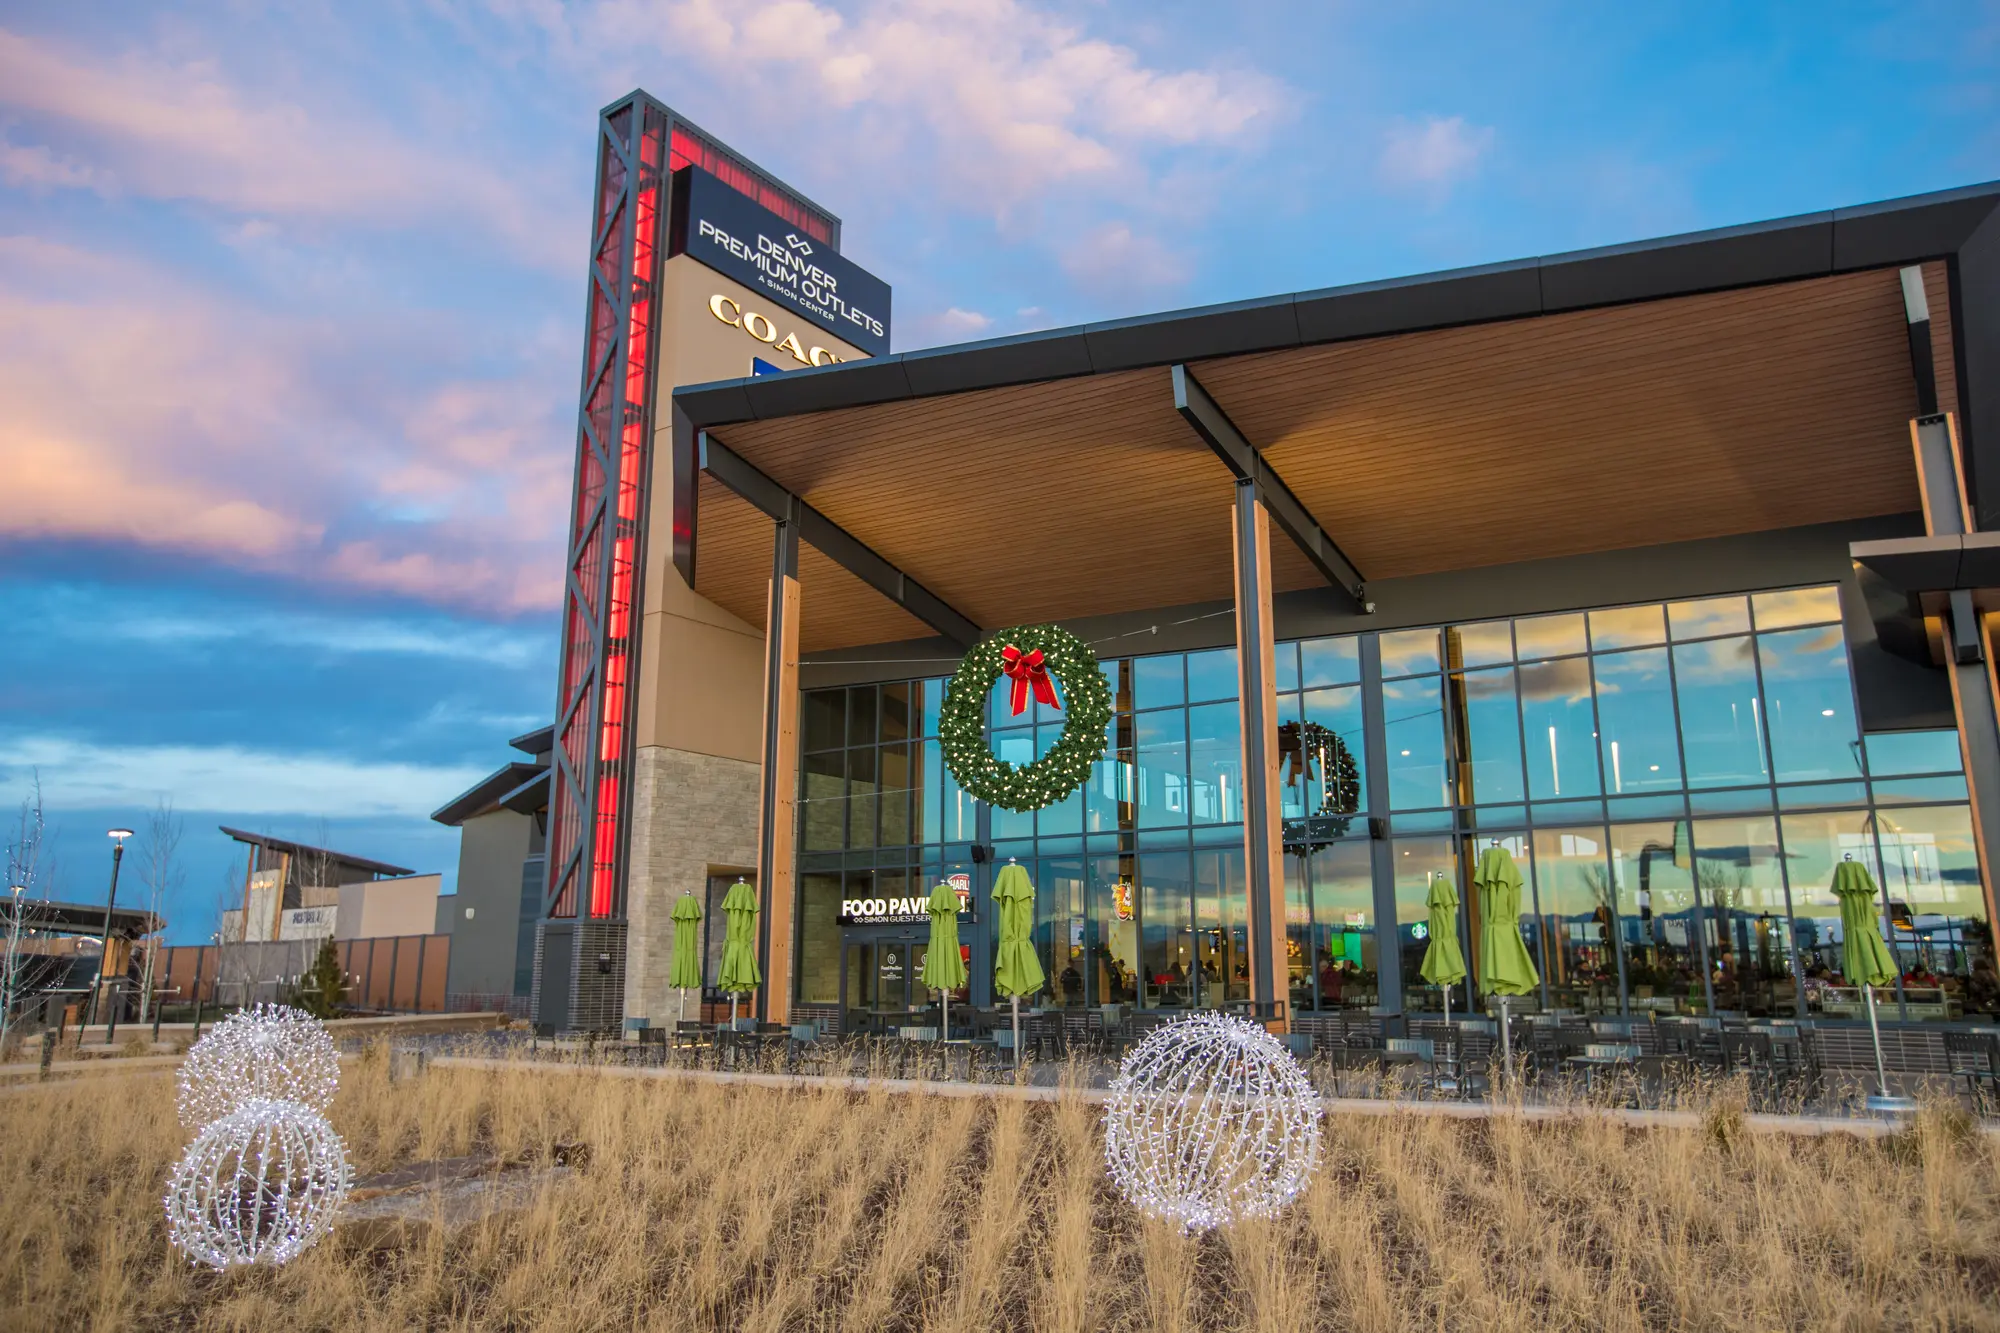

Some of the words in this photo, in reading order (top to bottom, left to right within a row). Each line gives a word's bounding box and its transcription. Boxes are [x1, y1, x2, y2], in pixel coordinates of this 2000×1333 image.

[699, 219, 797, 288] PREMIUM
[802, 280, 884, 337] OUTLETS
[757, 234, 837, 293] DENVER
[758, 275, 765, 284] A
[767, 279, 797, 301] SIMON
[800, 298, 835, 322] CENTER
[708, 294, 846, 367] COAC
[842, 899, 887, 916] FOOD
[889, 896, 966, 916] PAVI
[947, 879, 970, 890] HARL
[864, 915, 889, 924] SIMON
[889, 914, 915, 923] GUEST
